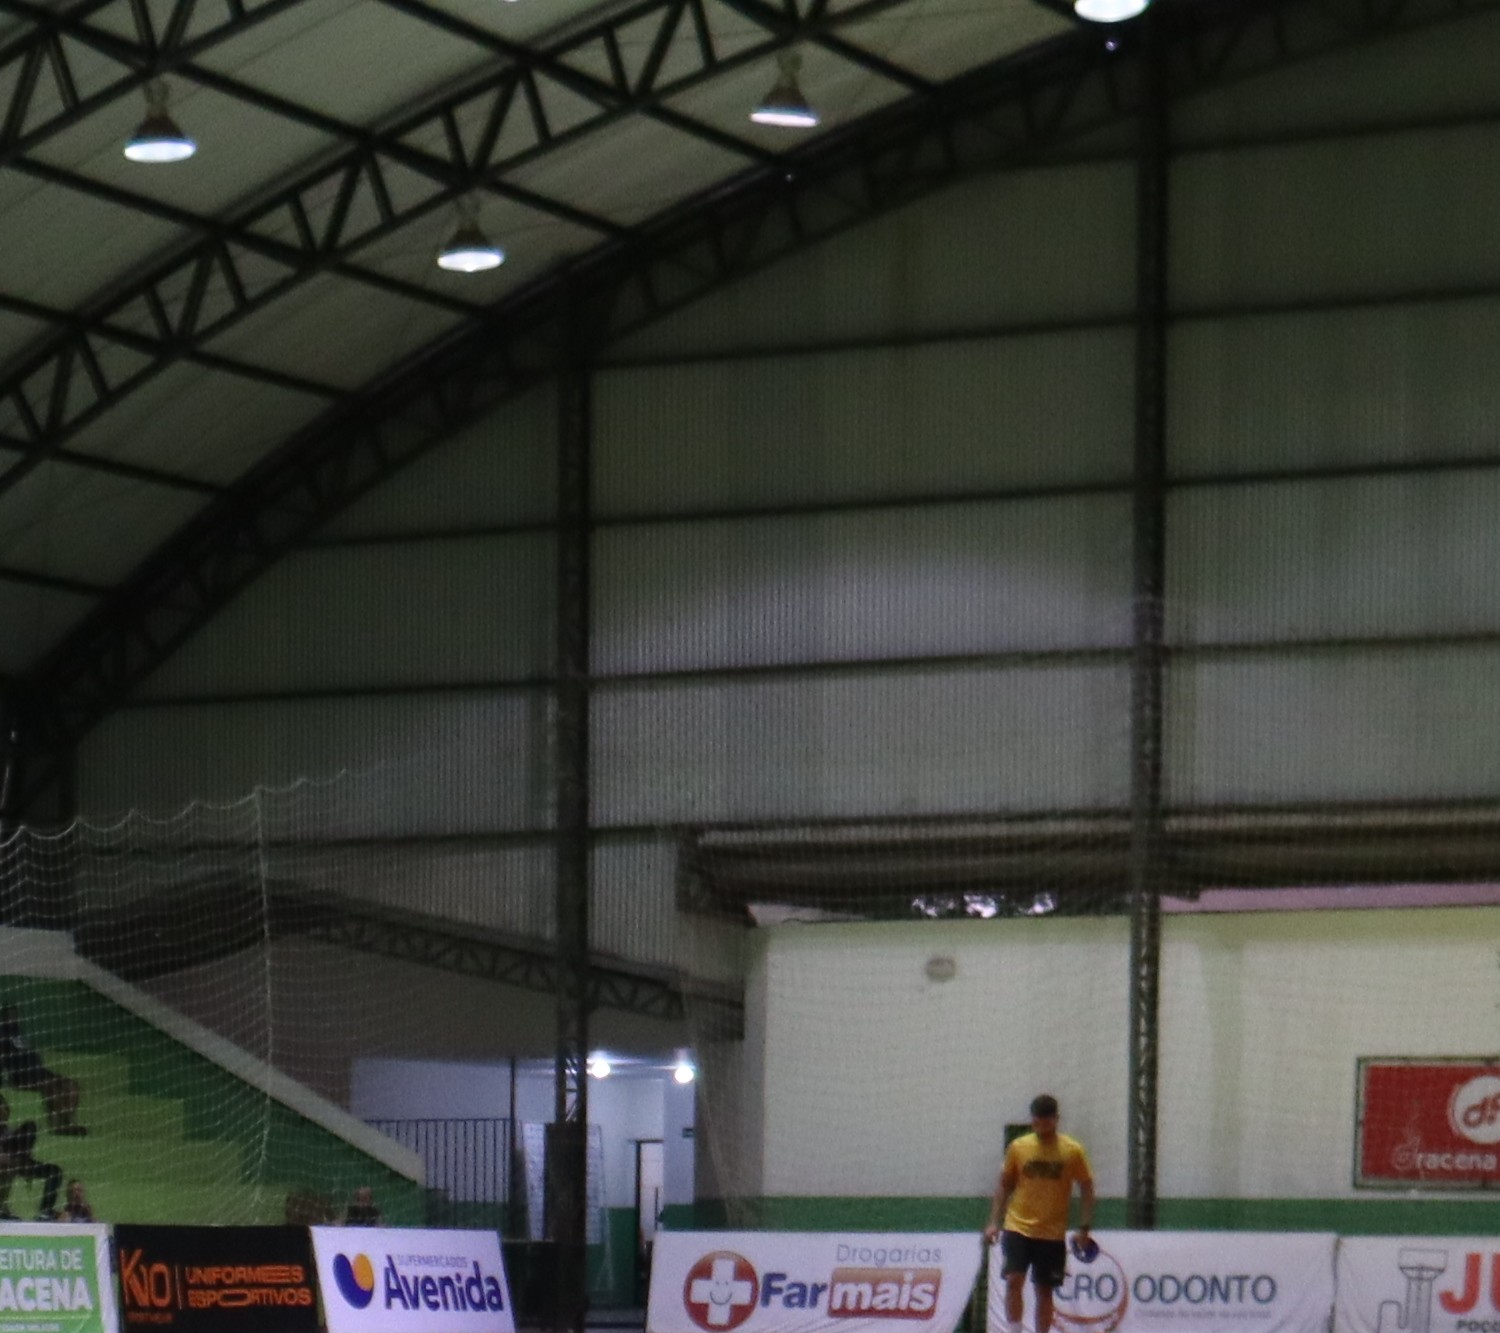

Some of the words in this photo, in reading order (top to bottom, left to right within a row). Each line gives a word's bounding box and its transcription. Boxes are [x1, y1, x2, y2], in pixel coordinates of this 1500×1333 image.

[60, 1250, 83, 1270] DE
[836, 1244, 942, 1267] Drogarias
[384, 1254, 503, 1312] Avenida
[1133, 1274, 1277, 1304] ODONTO
[187, 1287, 312, 1308] ESPORTIVOS
